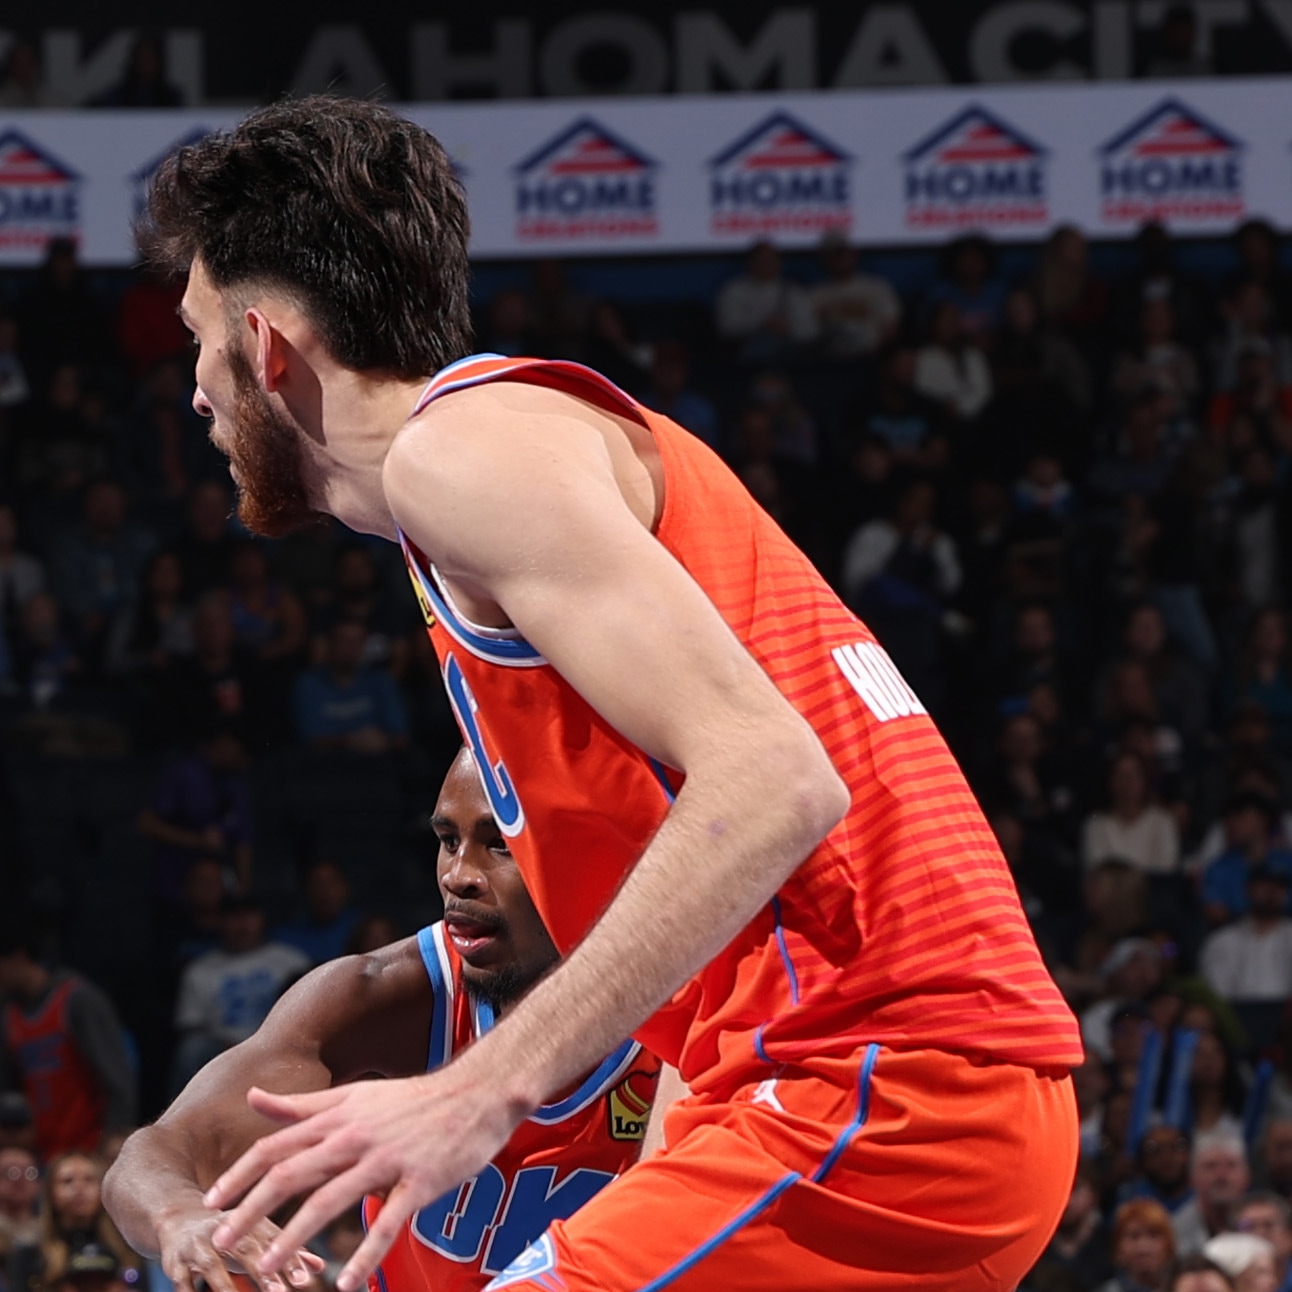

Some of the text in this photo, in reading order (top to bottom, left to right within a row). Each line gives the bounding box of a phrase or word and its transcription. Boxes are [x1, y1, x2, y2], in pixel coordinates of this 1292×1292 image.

[518, 177, 656, 213] HOME
[712, 173, 850, 207] HOME
[906, 165, 1044, 200] HOME
[1102, 160, 1241, 195] HOME
